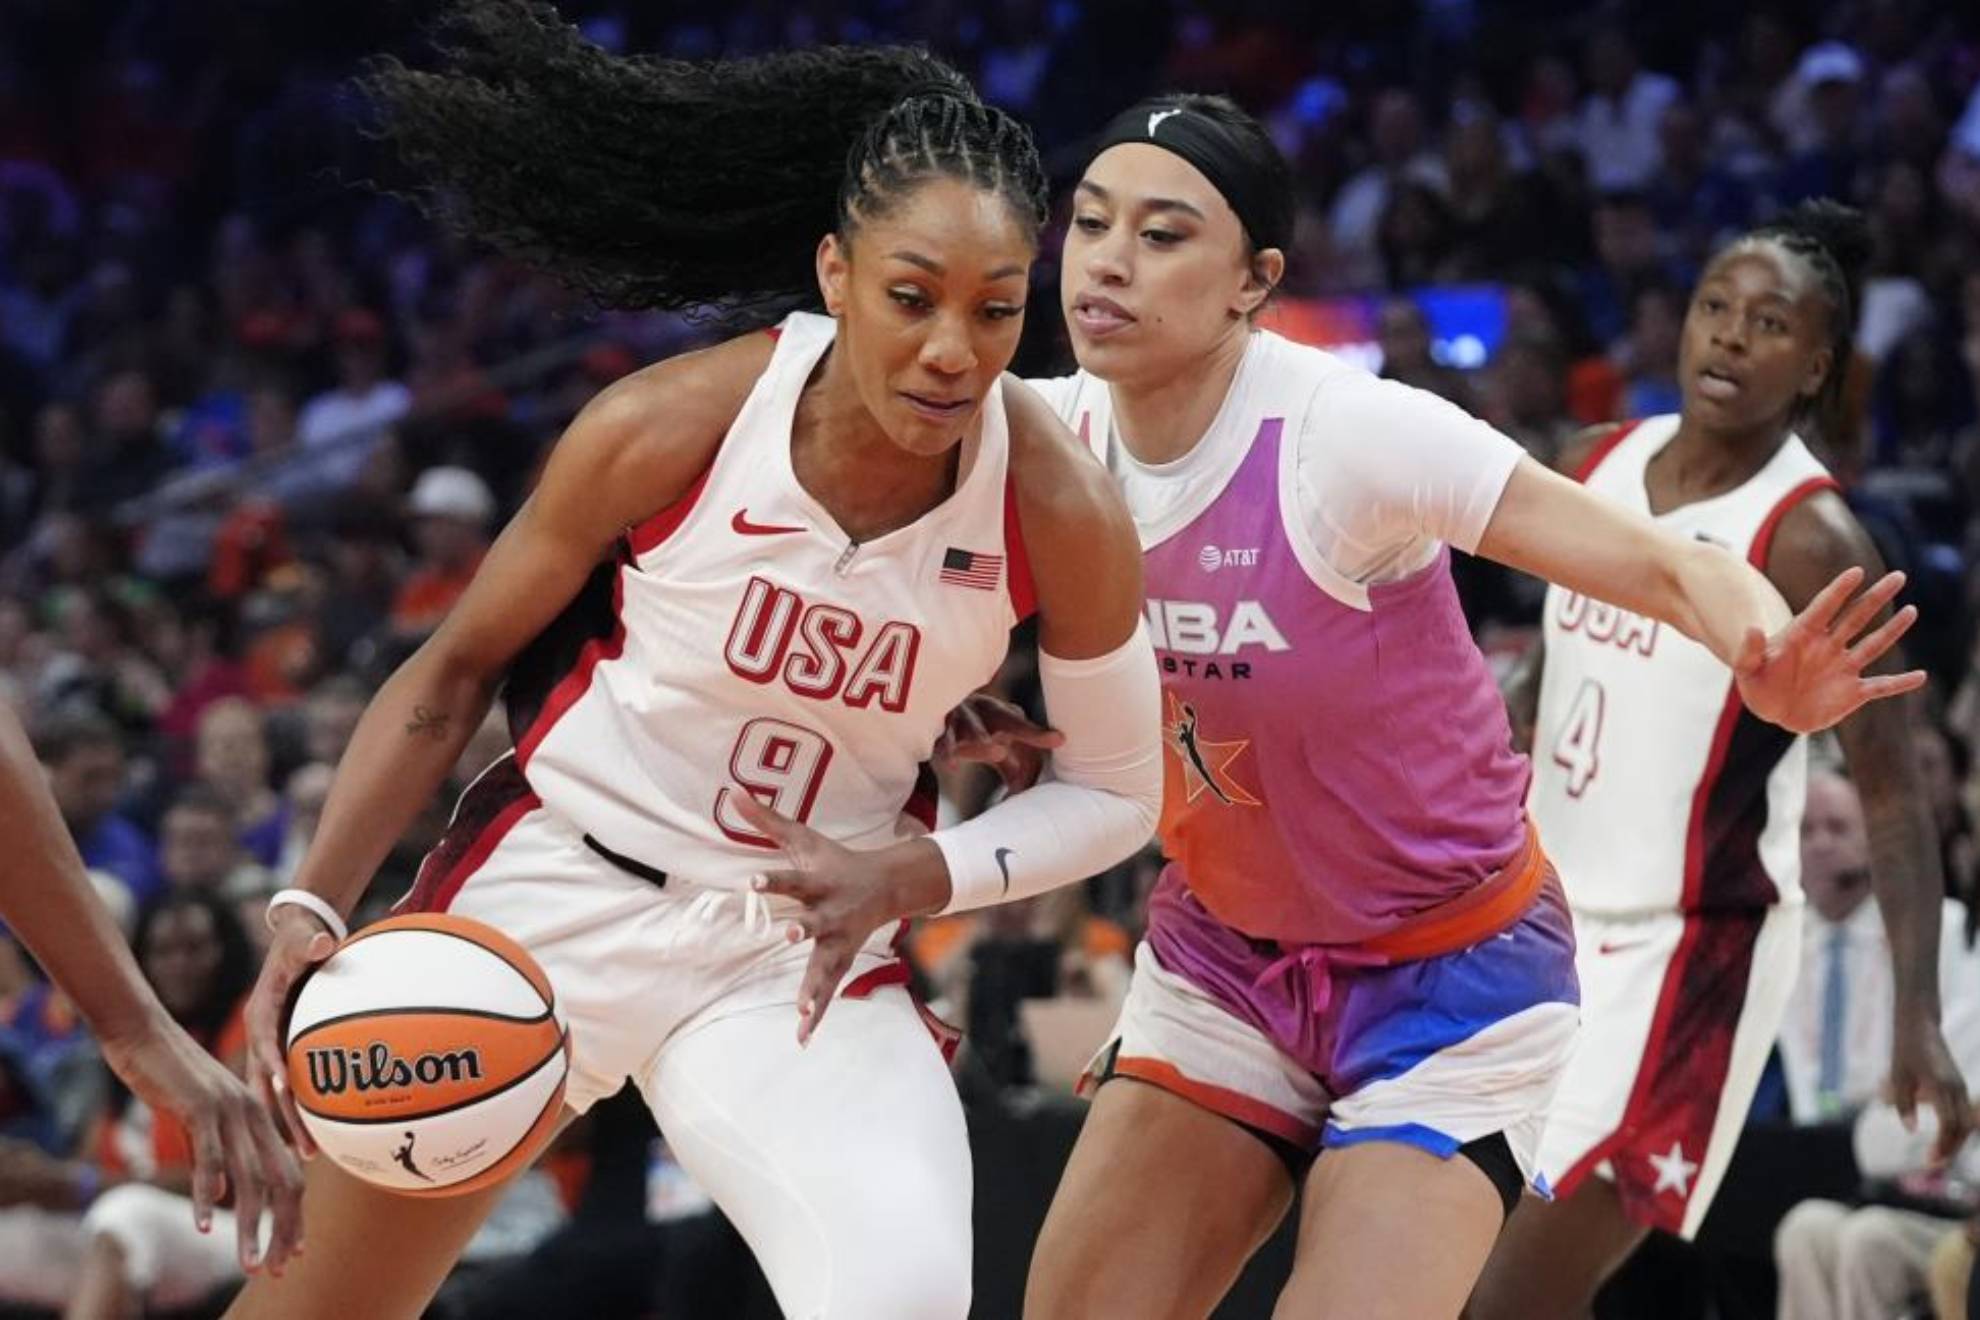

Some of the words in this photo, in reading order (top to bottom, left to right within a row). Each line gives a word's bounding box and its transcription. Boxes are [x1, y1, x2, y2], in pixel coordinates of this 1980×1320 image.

[1223, 549, 1260, 567] AT&T
[724, 575, 921, 713] USA
[1163, 657, 1252, 680] STAR
[1552, 674, 1605, 799] 4
[714, 716, 834, 850] 9
[306, 1043, 481, 1094] Wilson
